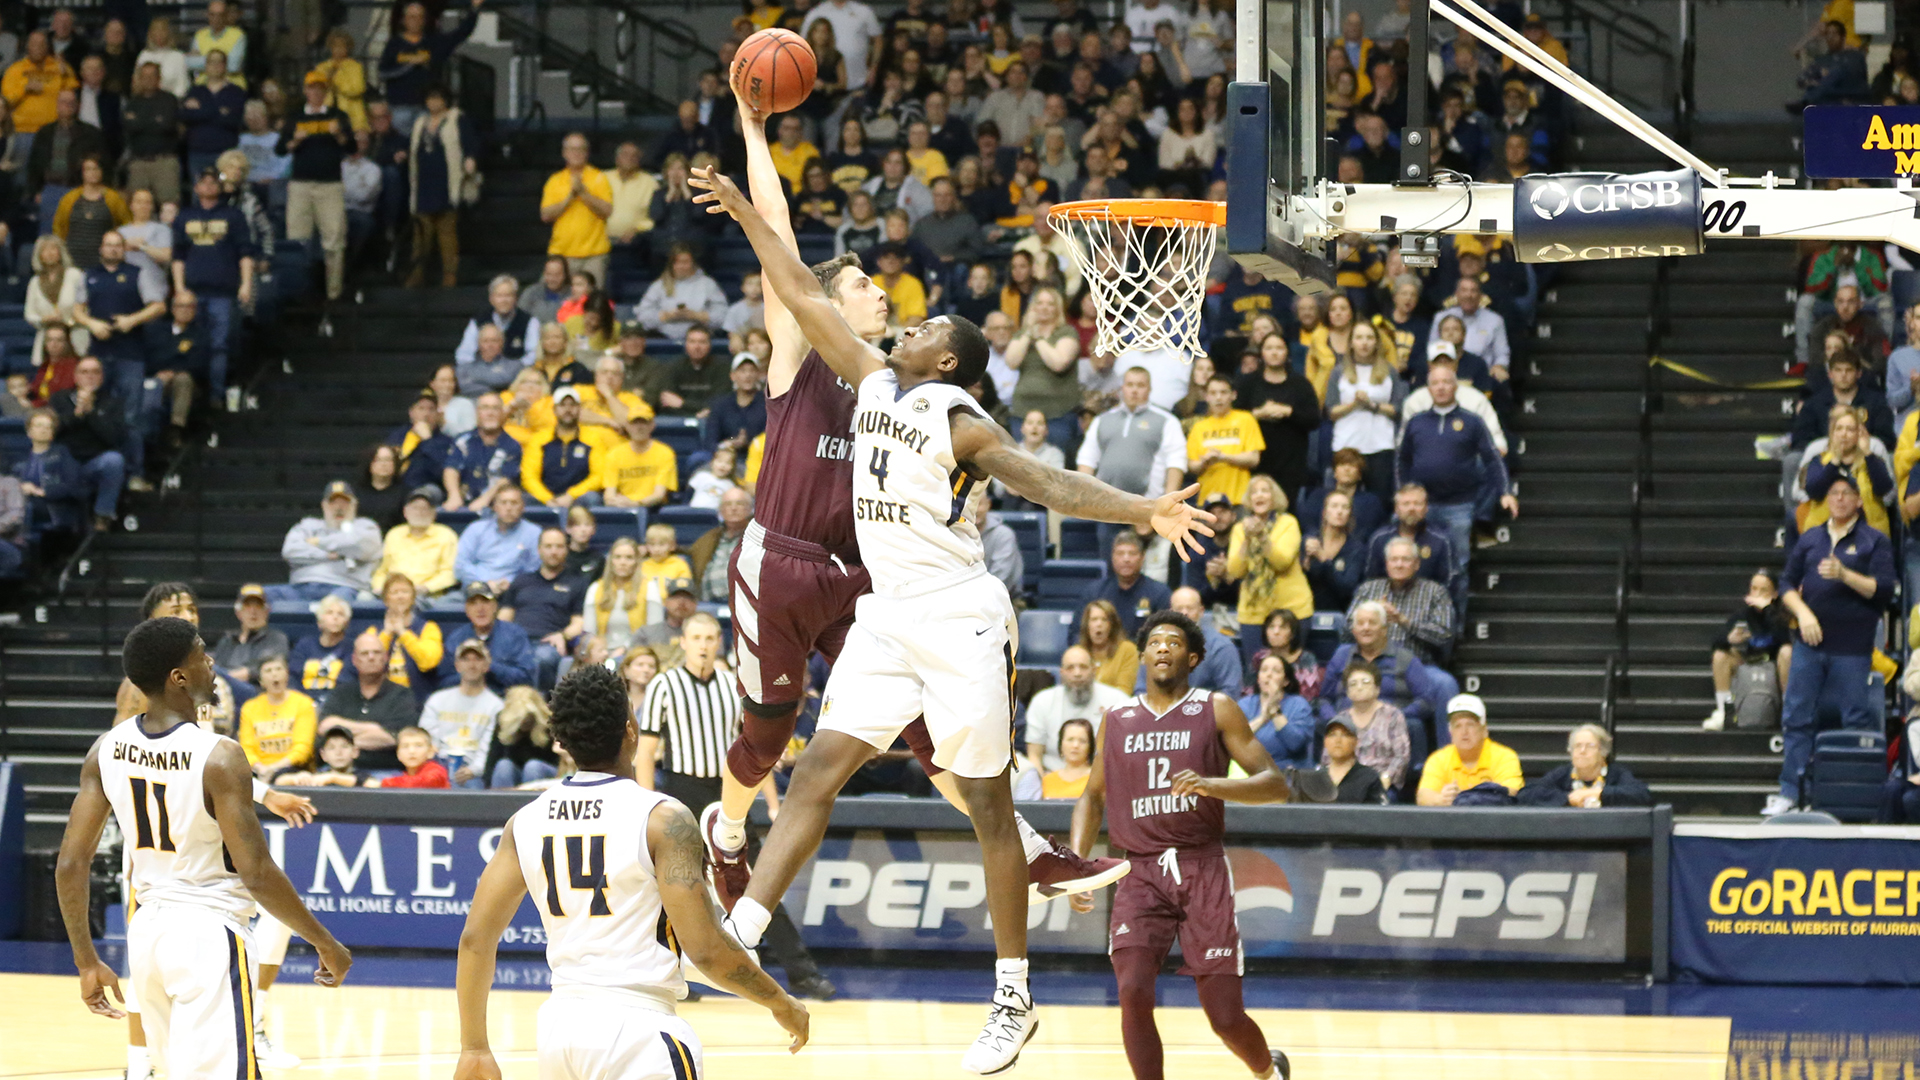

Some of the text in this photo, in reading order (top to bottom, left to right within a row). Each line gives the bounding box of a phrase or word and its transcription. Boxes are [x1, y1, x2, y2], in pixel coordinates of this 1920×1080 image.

[1572, 180, 1683, 214] CFSB
[1702, 200, 1747, 234] 00
[1523, 399, 1537, 414] K
[1781, 398, 1794, 415] K
[857, 410, 931, 455] MURRAY
[869, 445, 892, 492] 4
[856, 496, 911, 526] STATE
[1496, 526, 1511, 543] G
[79, 559, 91, 576] F
[1487, 574, 1500, 590] F
[35, 605, 48, 623] E
[1476, 622, 1490, 639] E
[1465, 675, 1481, 693] D
[1124, 730, 1191, 754] EASTERN
[1769, 735, 1784, 754] C
[113, 740, 193, 771] BUCHANAN
[1147, 757, 1172, 790] 12
[127, 775, 178, 855] 11
[548, 799, 604, 820] EAVES
[541, 833, 615, 918] 14
[340, 897, 393, 914] HOME
[394, 899, 410, 915] &
[411, 899, 471, 915] CREMA
[803, 860, 1073, 932] PEPI
[1311, 868, 1598, 940] PEPSI
[1706, 919, 1733, 934] THE
[1734, 919, 1790, 935] OFFICIAL
[1792, 920, 1849, 936] WEBSITE
[1850, 921, 1868, 936] OF
[1205, 948, 1233, 958] EKU
